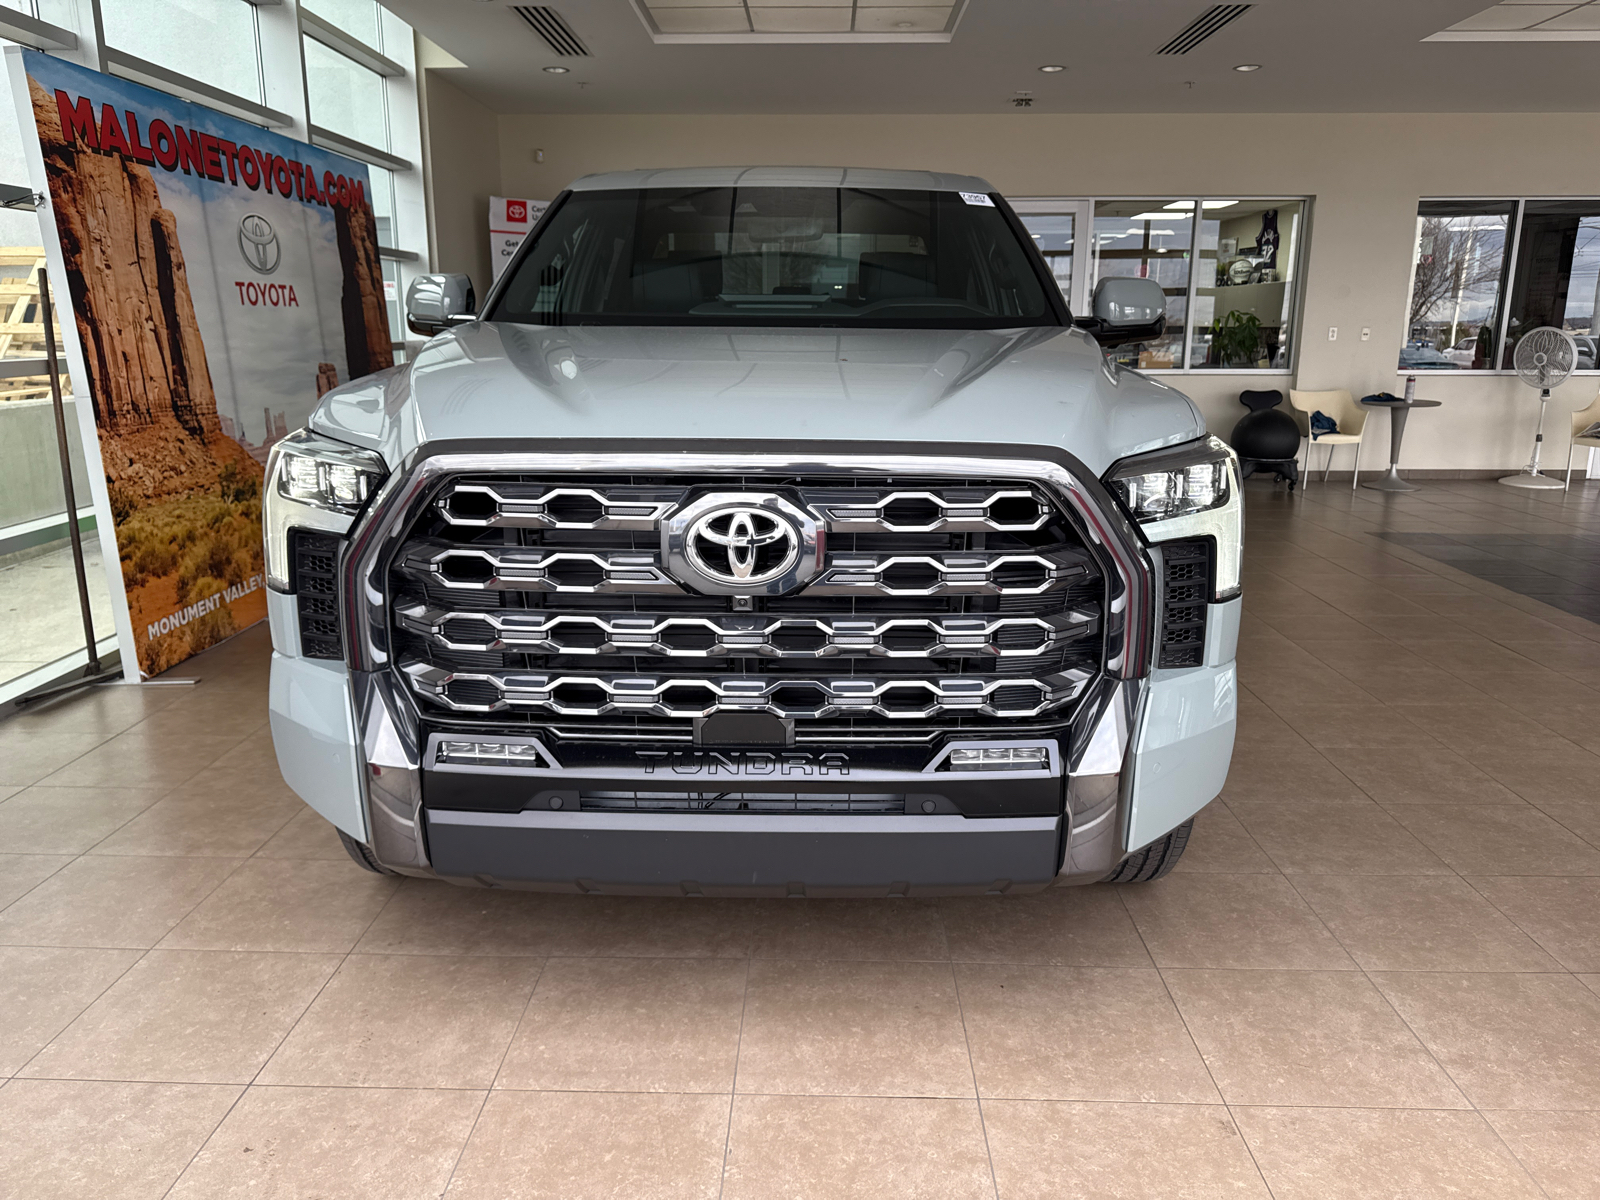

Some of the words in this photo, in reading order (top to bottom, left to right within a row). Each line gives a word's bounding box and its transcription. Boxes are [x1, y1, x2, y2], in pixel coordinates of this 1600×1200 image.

[53, 88, 366, 209] MALONETOYOTA.COM
[234, 281, 299, 307] TOYOTA
[147, 592, 221, 640] MONUMENT
[635, 751, 850, 776] TUNDRA
